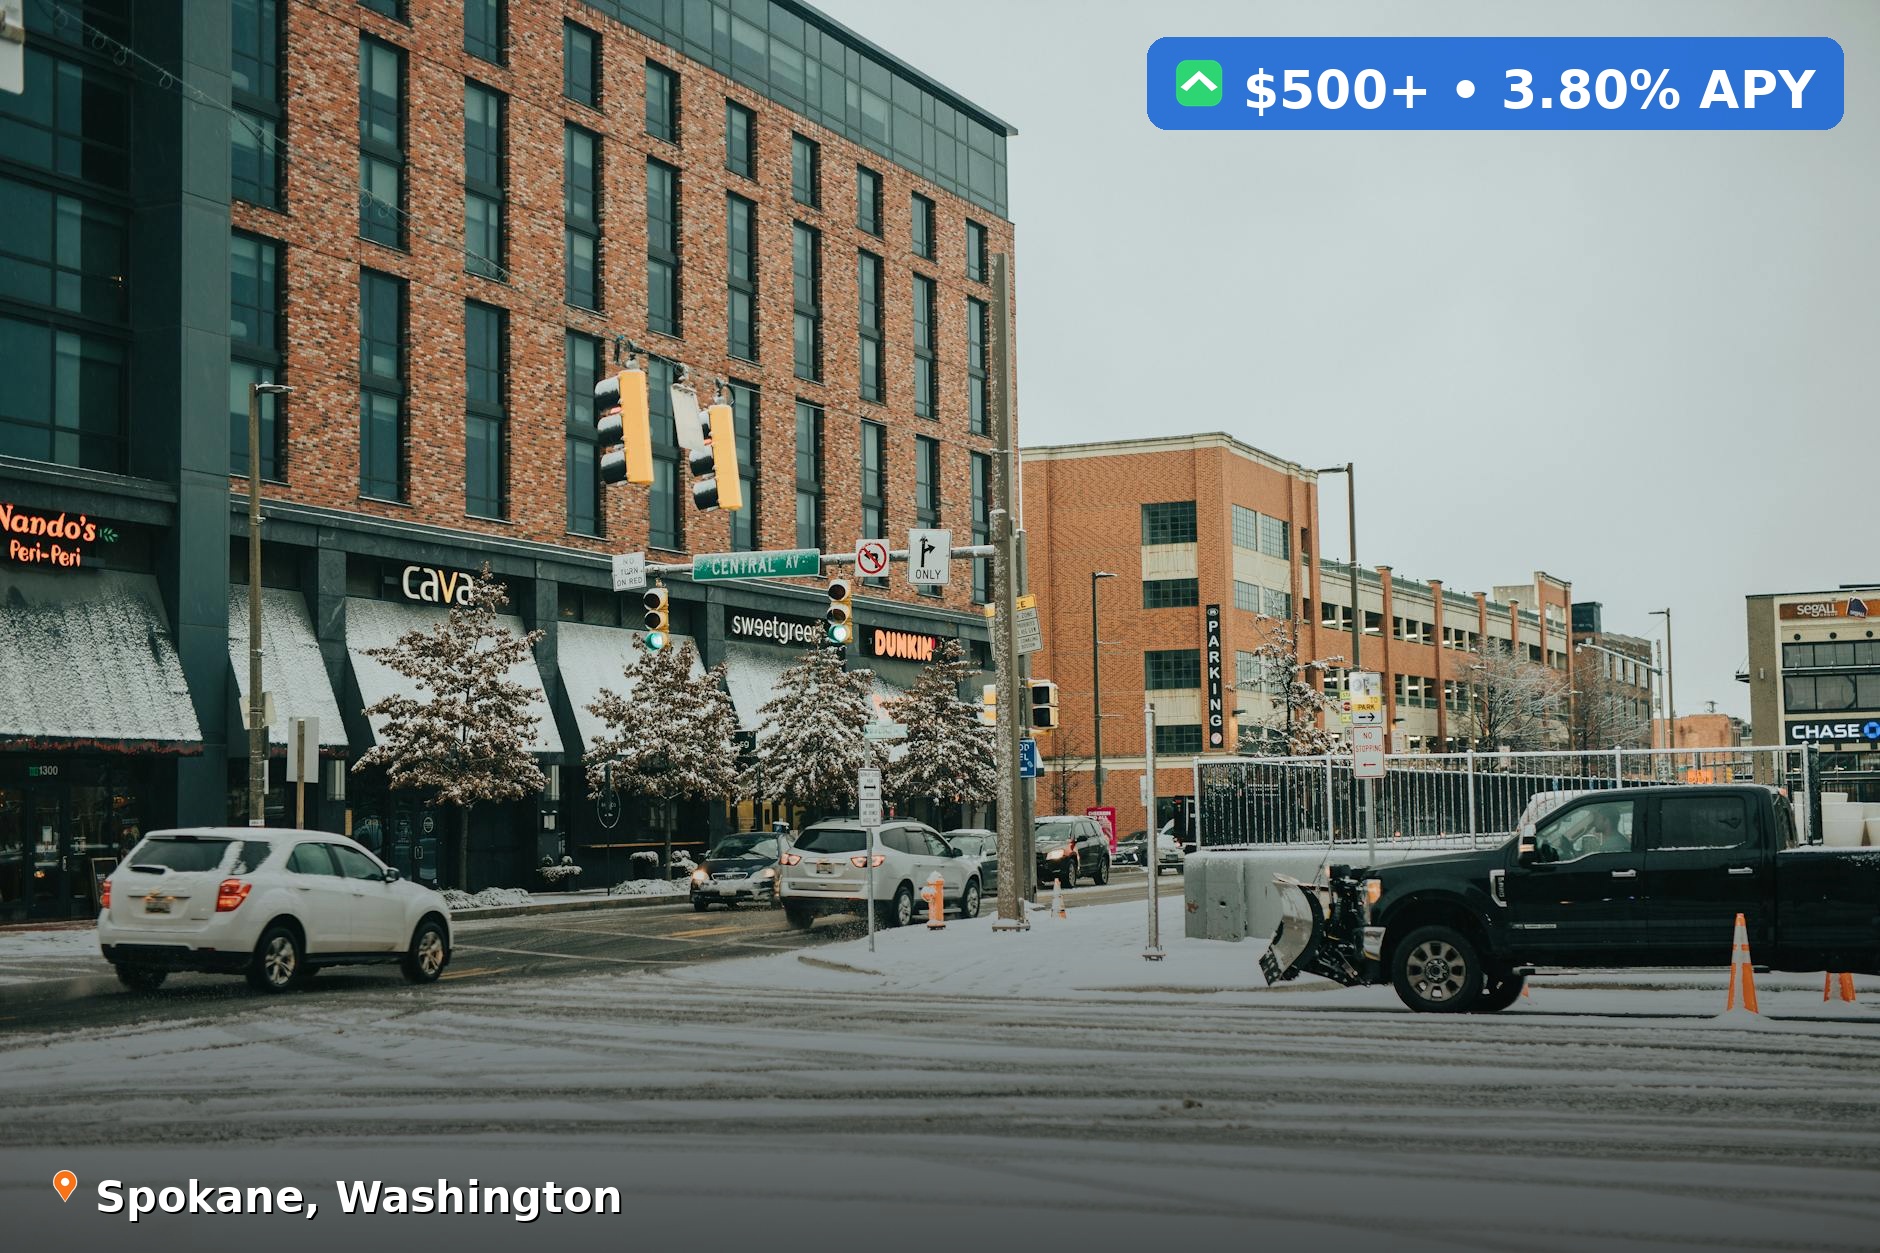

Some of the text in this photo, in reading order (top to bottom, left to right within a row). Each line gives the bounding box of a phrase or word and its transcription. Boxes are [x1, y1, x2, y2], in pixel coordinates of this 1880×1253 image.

[9, 539, 81, 567] Peri-Peri
[712, 554, 799, 576] CENTRAL AV
[620, 567, 639, 577] TURN
[915, 569, 942, 580] ONLY
[629, 576, 643, 585] RED
[1208, 620, 1223, 727] PARKING
[1362, 732, 1372, 740] NO
[1792, 723, 1861, 739] CHASE
[1355, 745, 1382, 753] STOPPING
[39, 765, 59, 776] 1300
